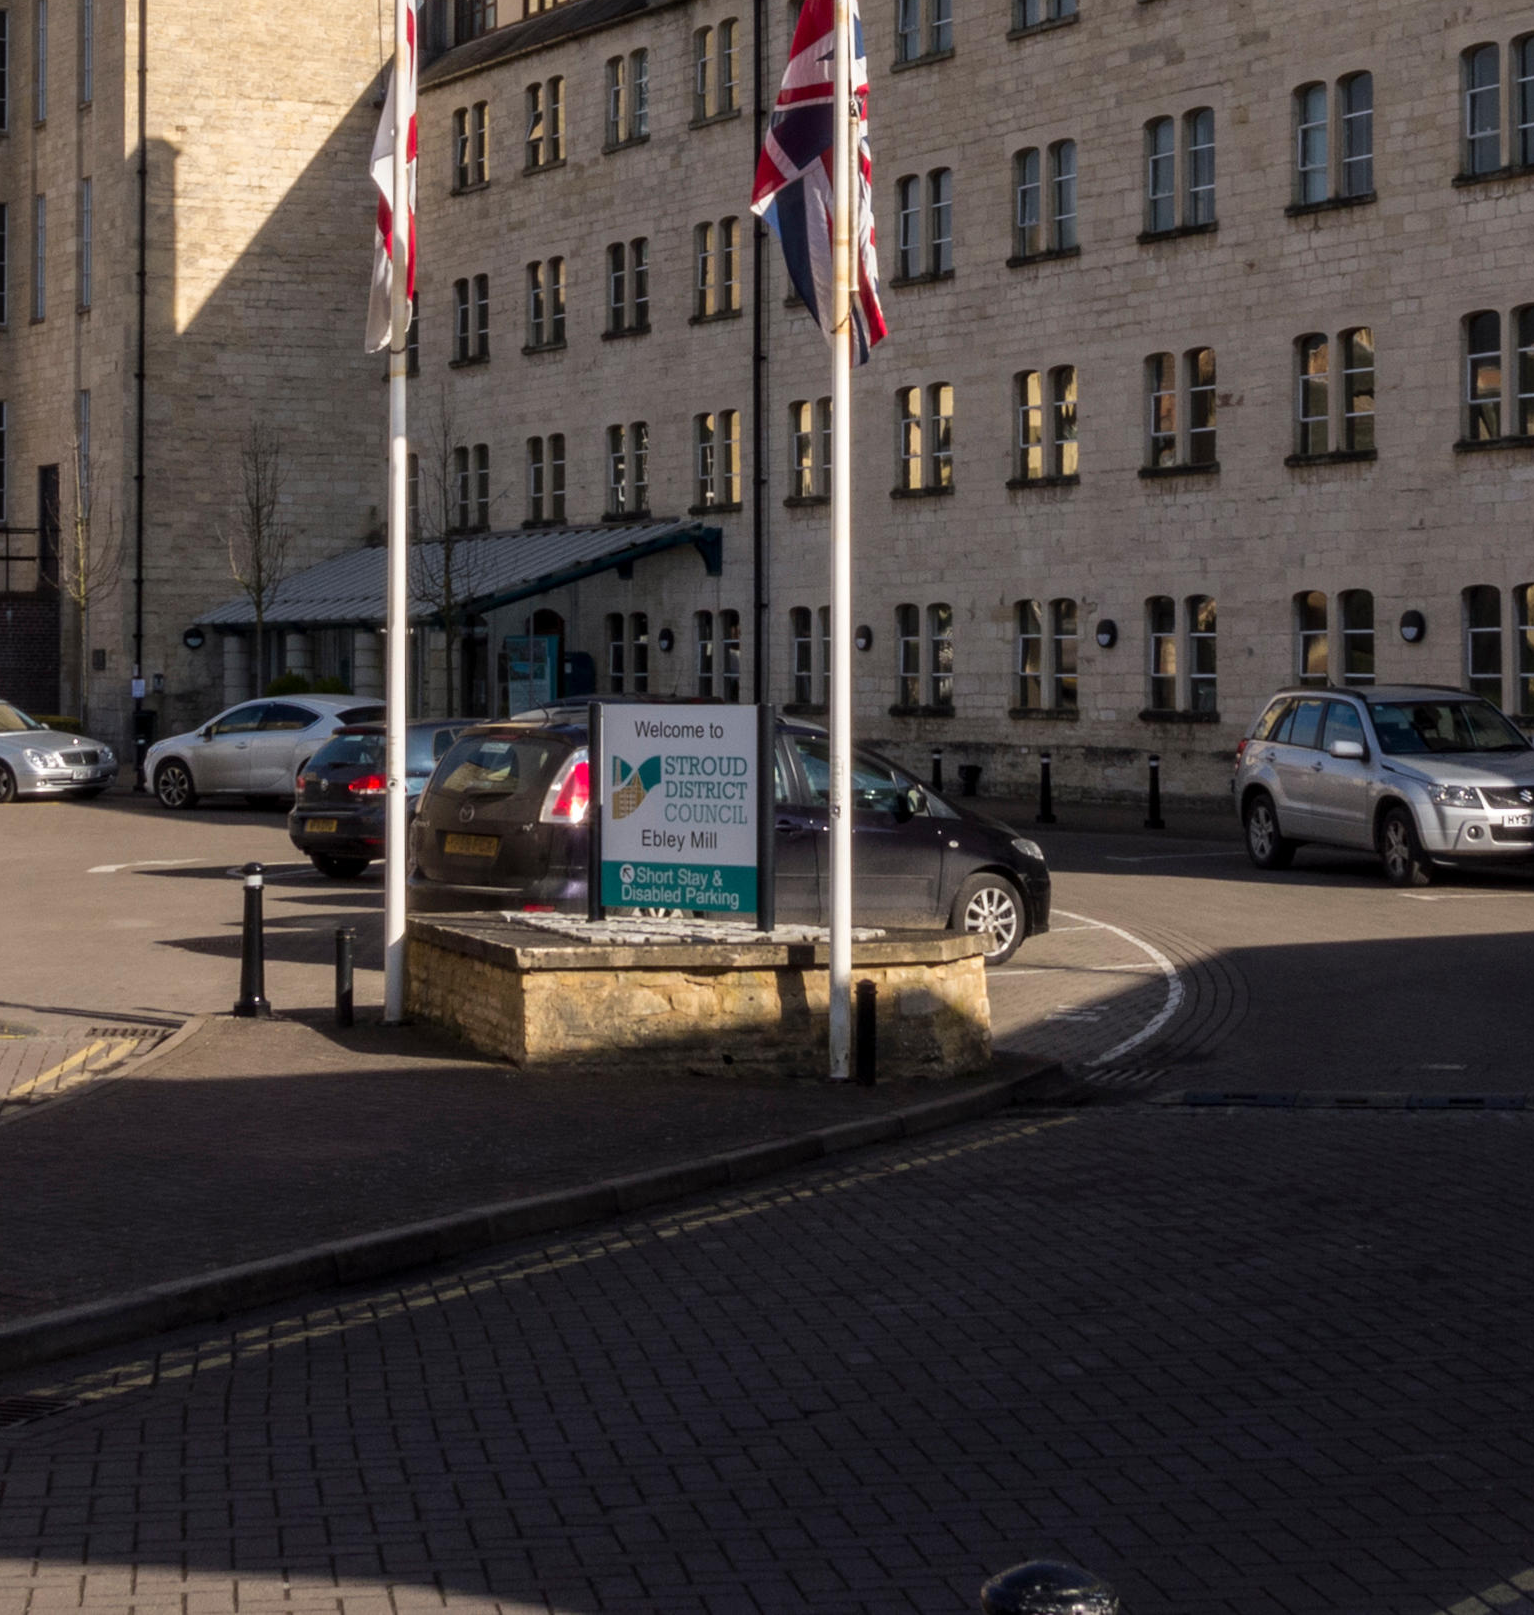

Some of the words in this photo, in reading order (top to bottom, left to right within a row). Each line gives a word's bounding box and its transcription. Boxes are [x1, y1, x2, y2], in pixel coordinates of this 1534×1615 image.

[635, 721, 705, 739] Welcome
[709, 722, 724, 739] to
[665, 755, 747, 776] STROUD
[665, 780, 748, 800] DISTRICT
[665, 804, 748, 825] COUNCIL
[1508, 814, 1534, 825] HY57
[641, 829, 685, 852] Ebley
[690, 831, 718, 850] Mill
[636, 868, 674, 885] Short
[678, 869, 709, 890] Stay
[712, 871, 723, 886] &
[621, 884, 682, 904] Disabled
[685, 888, 740, 910] Parking
